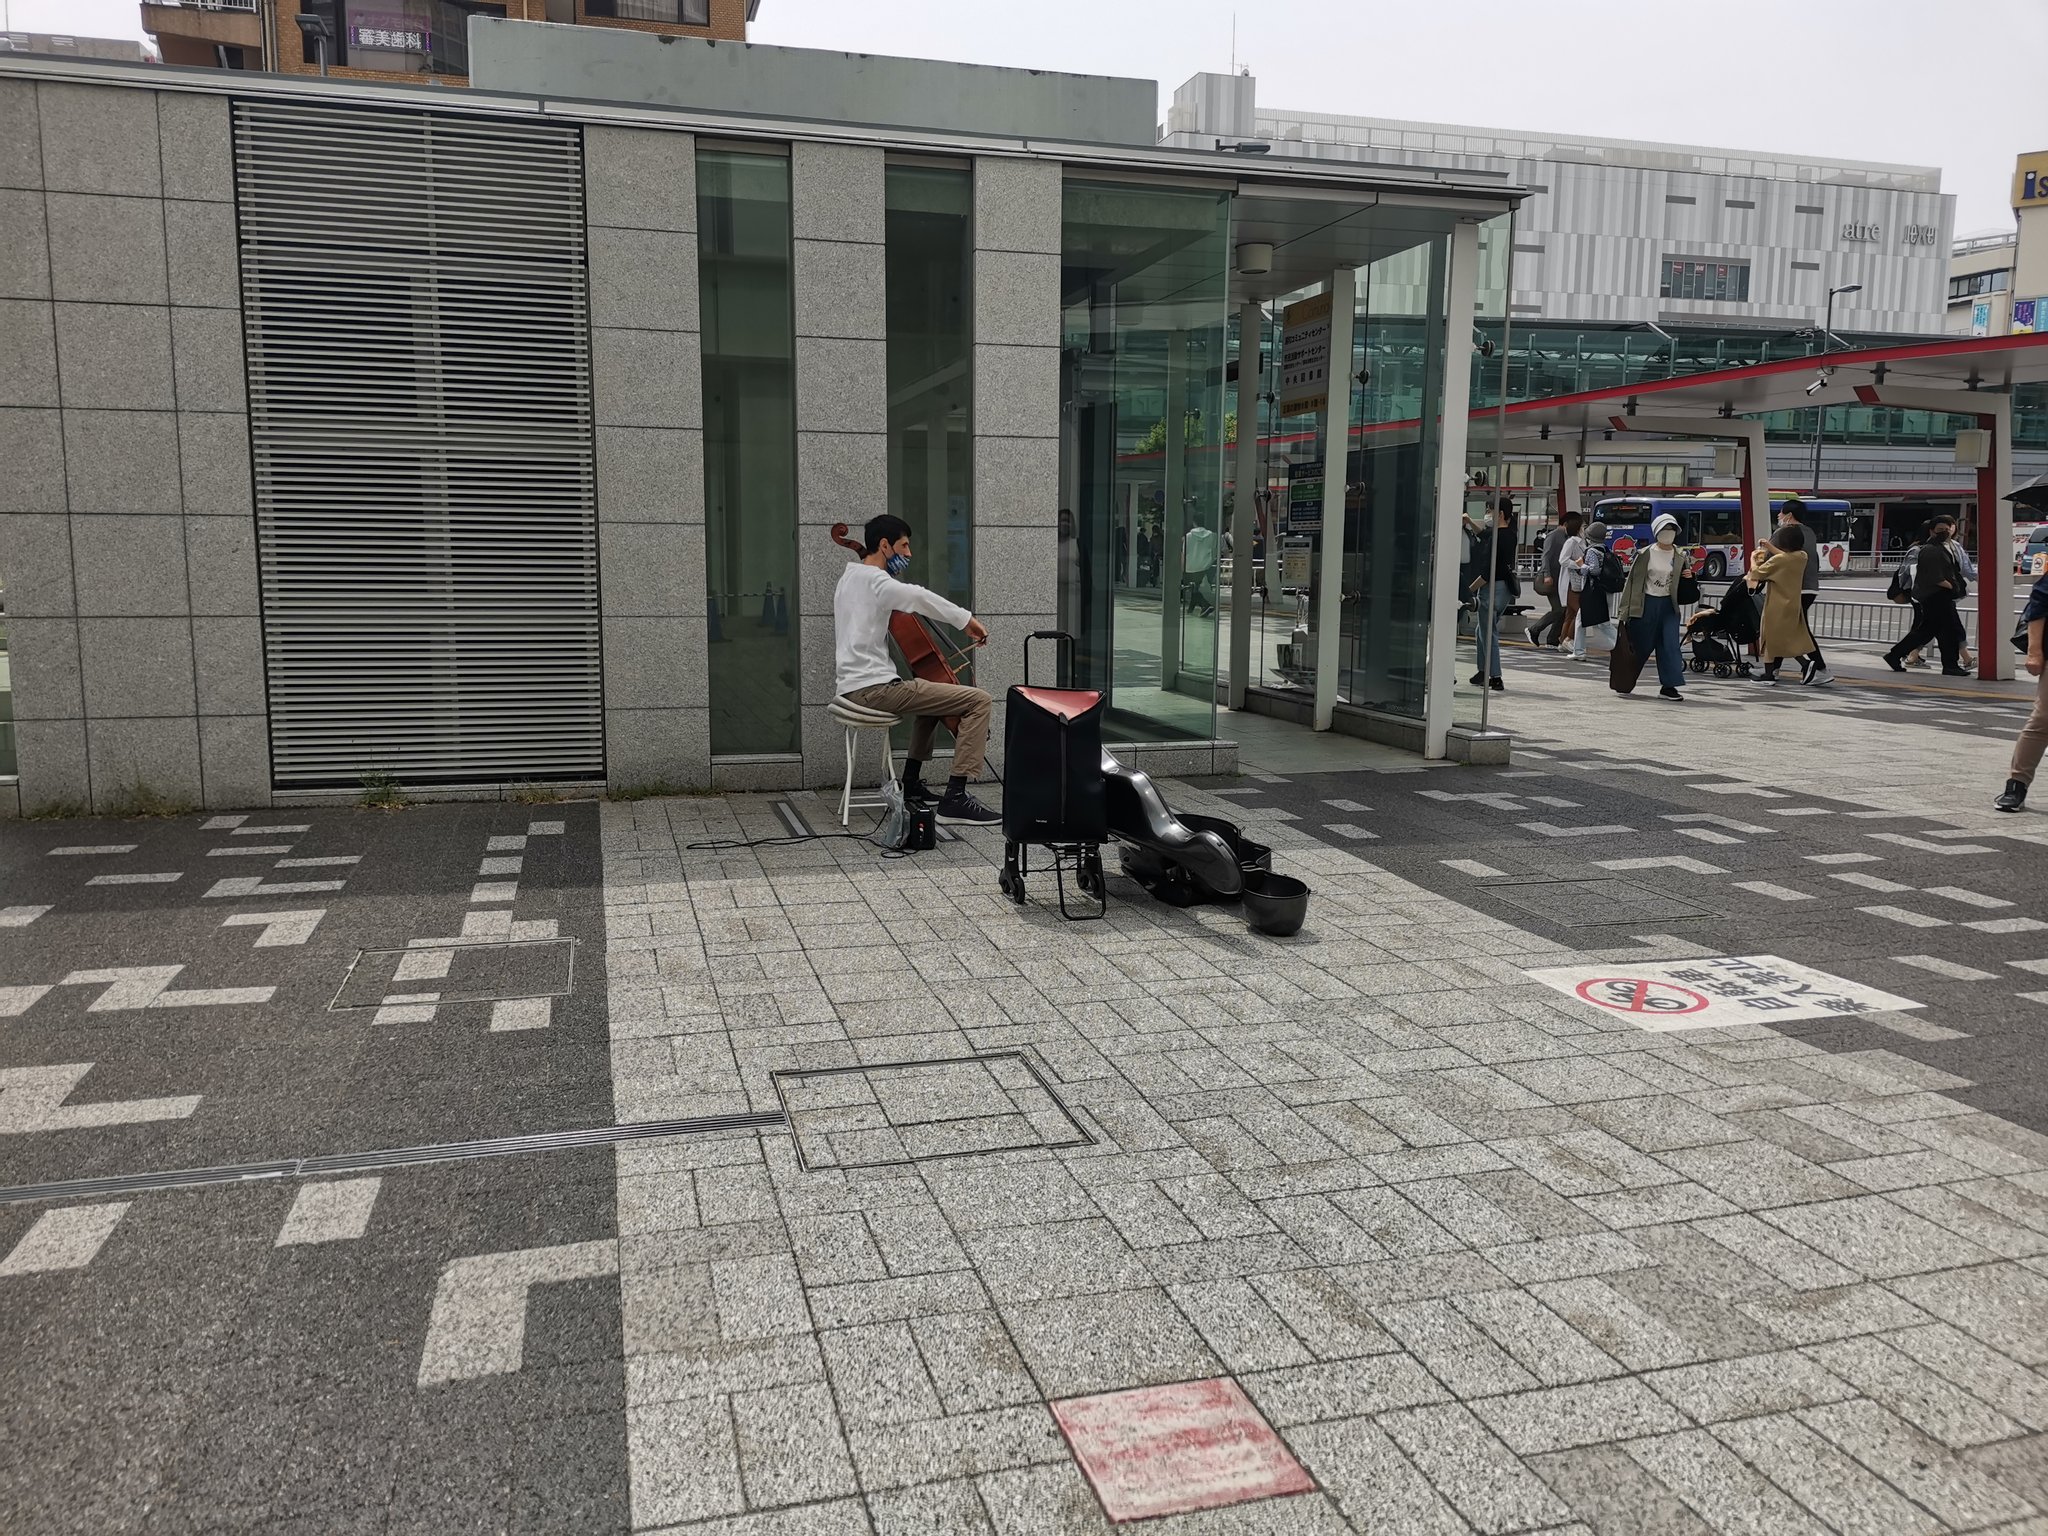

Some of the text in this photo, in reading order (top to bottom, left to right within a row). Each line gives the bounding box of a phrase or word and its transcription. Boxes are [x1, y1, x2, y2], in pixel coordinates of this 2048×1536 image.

[358, 28, 422, 49] 審美歯科
[1663, 968, 1800, 1011] 自転車
[1708, 958, 1882, 1014] 乗入禁止
